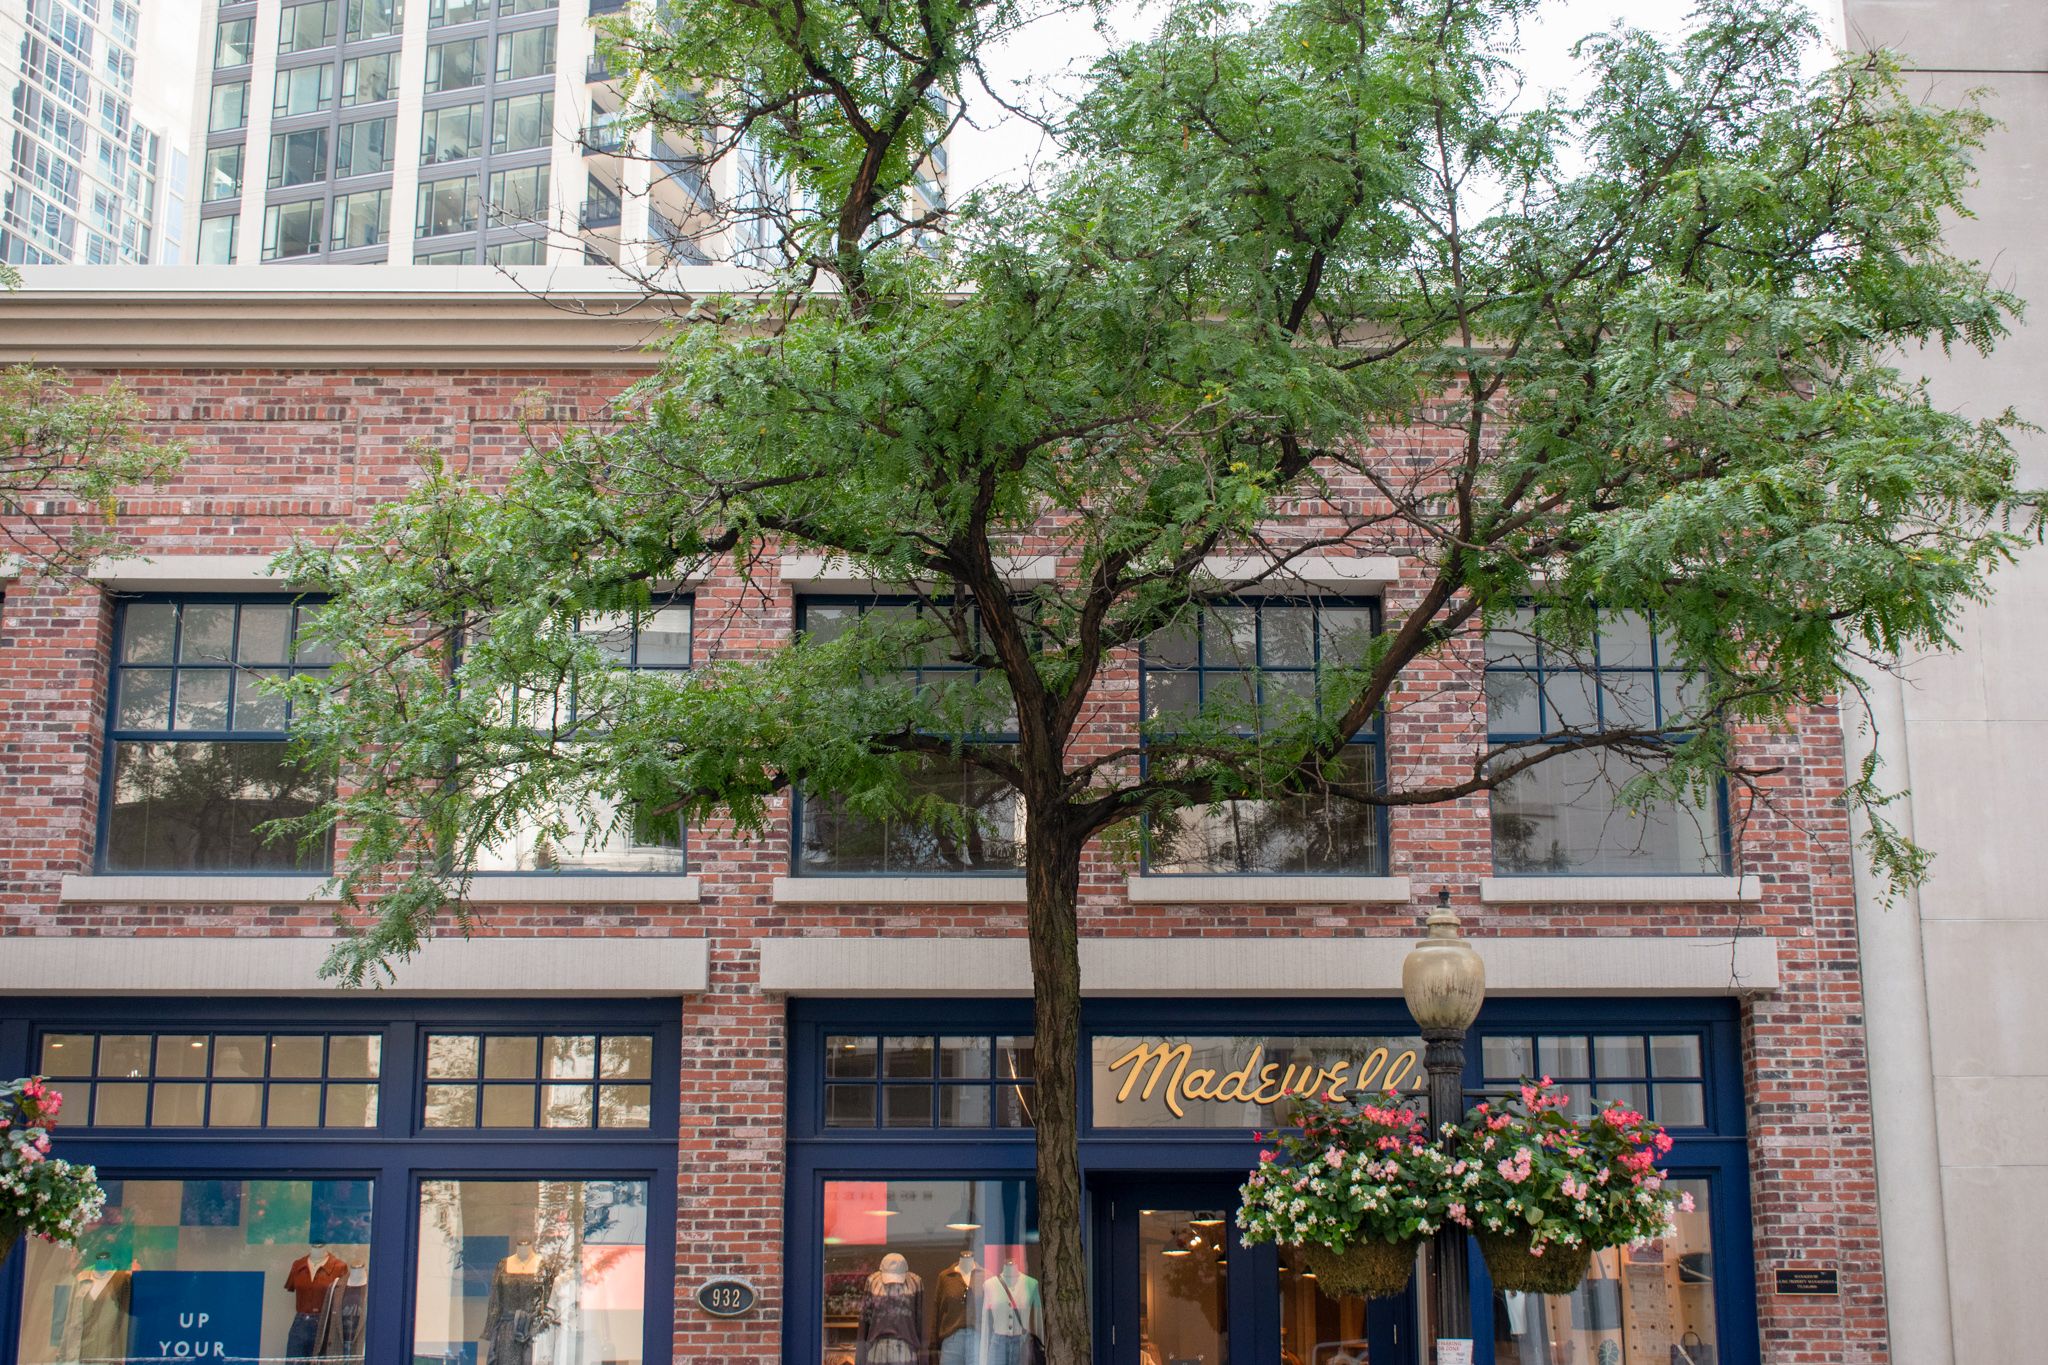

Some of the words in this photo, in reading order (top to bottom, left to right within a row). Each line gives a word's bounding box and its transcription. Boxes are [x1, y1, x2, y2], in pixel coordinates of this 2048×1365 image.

[1110, 1040, 1422, 1119] Madewell
[712, 1288, 741, 1308] 932
[179, 1312, 210, 1328] UP
[159, 1340, 225, 1357] YOUR
